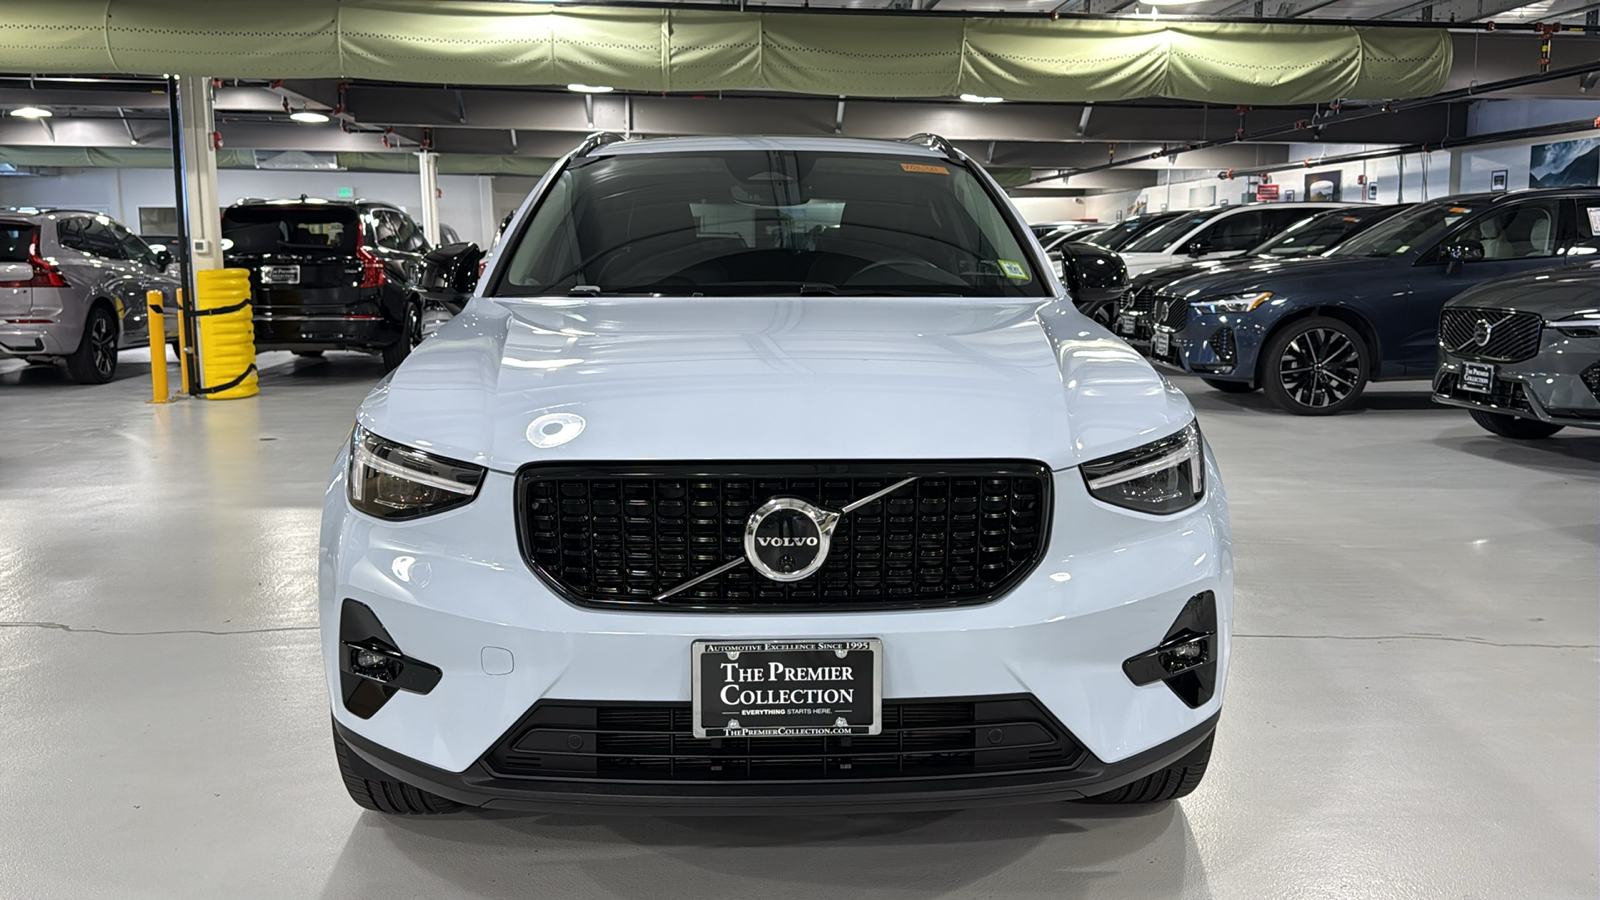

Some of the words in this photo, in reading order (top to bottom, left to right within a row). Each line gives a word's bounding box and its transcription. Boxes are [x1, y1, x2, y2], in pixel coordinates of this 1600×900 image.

[757, 537, 818, 547] VOLVO
[707, 644, 764, 652] AUTOMOTIVE
[765, 643, 816, 651] EXCELLENCE
[818, 642, 843, 650] SINCE
[845, 642, 868, 650] 1995
[720, 662, 764, 683] THE
[768, 661, 854, 682] PREMIER
[720, 684, 854, 705] COLLECTION
